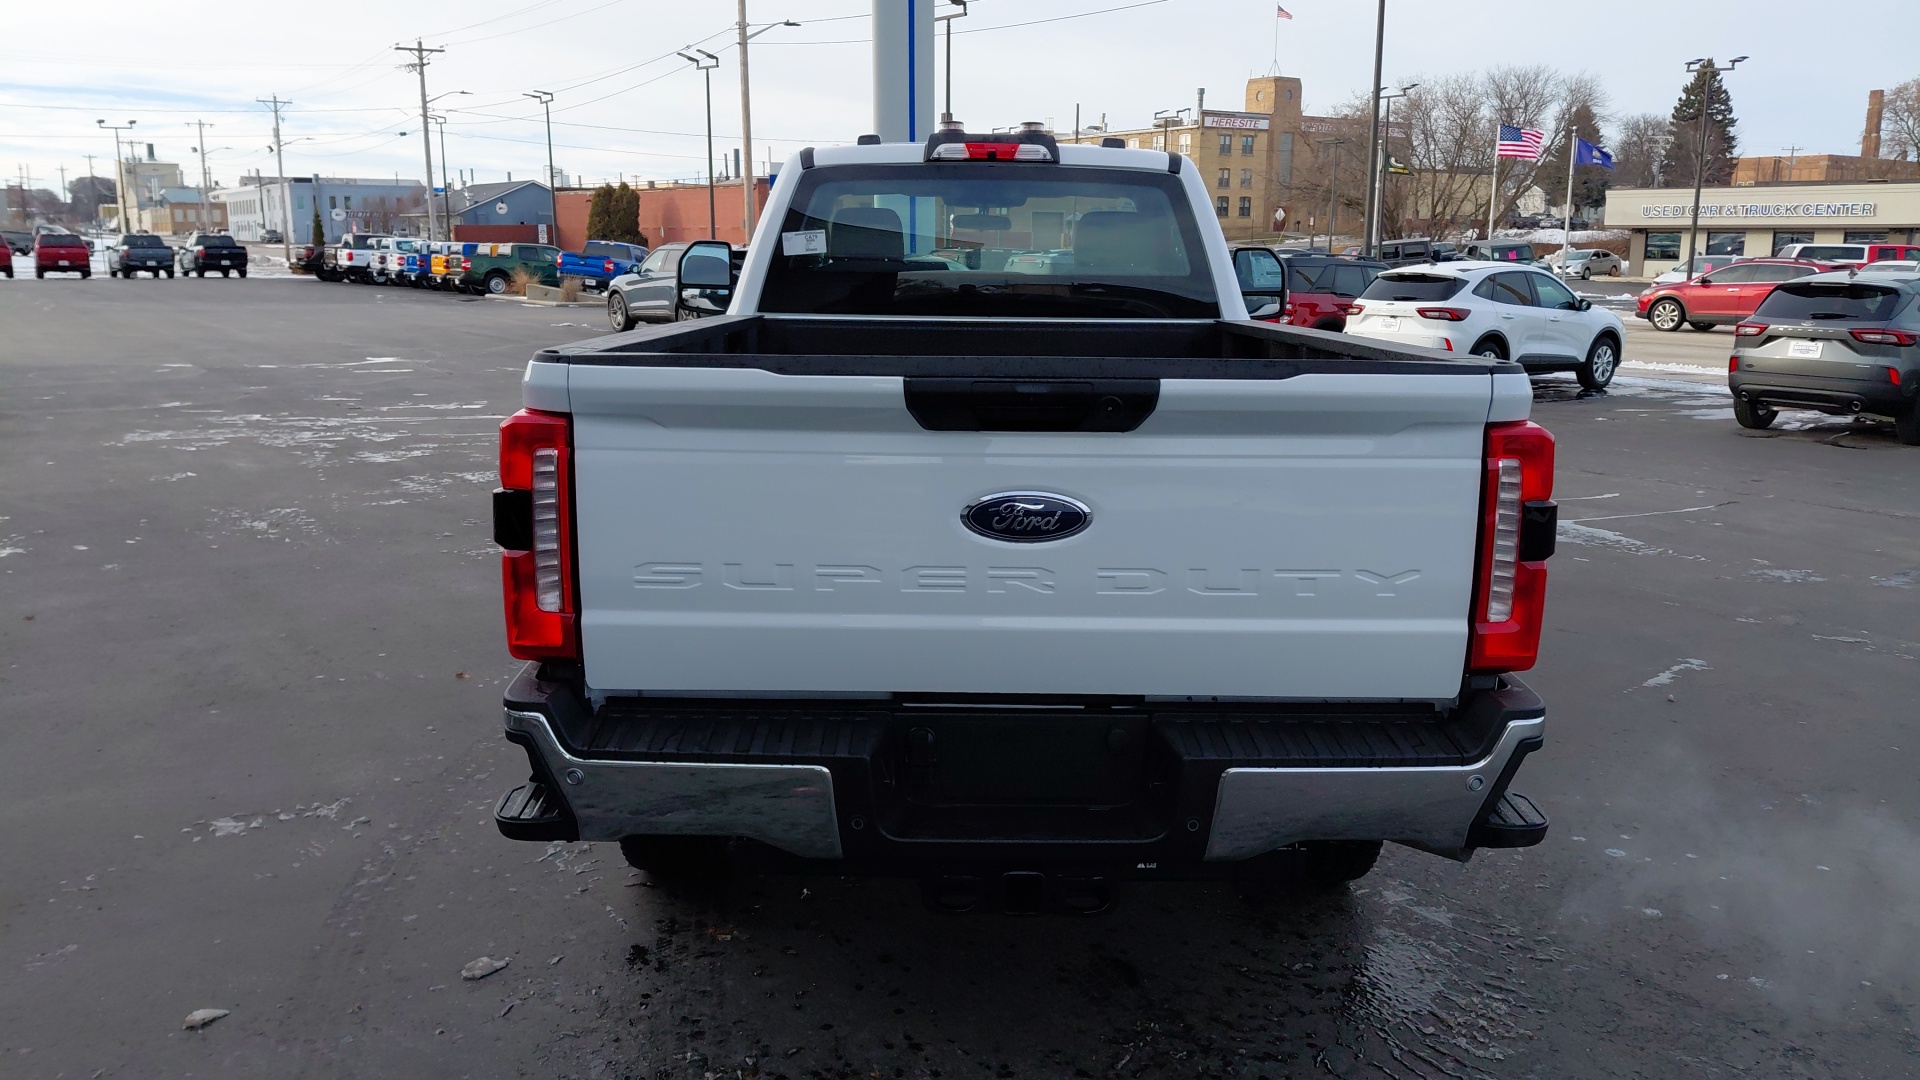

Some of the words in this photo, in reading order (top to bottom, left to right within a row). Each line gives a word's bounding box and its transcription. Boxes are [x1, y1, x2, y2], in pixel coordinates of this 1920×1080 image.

[1211, 117, 1261, 128] HERESITE
[1642, 204, 1683, 217] USED
[1724, 204, 1736, 216] &
[1738, 203, 1799, 216] TRUCK
[1801, 202, 1875, 216] CENTER
[988, 502, 1061, 531] Ford
[634, 562, 1055, 594] SUPER
[1096, 567, 1421, 597] DUTY
